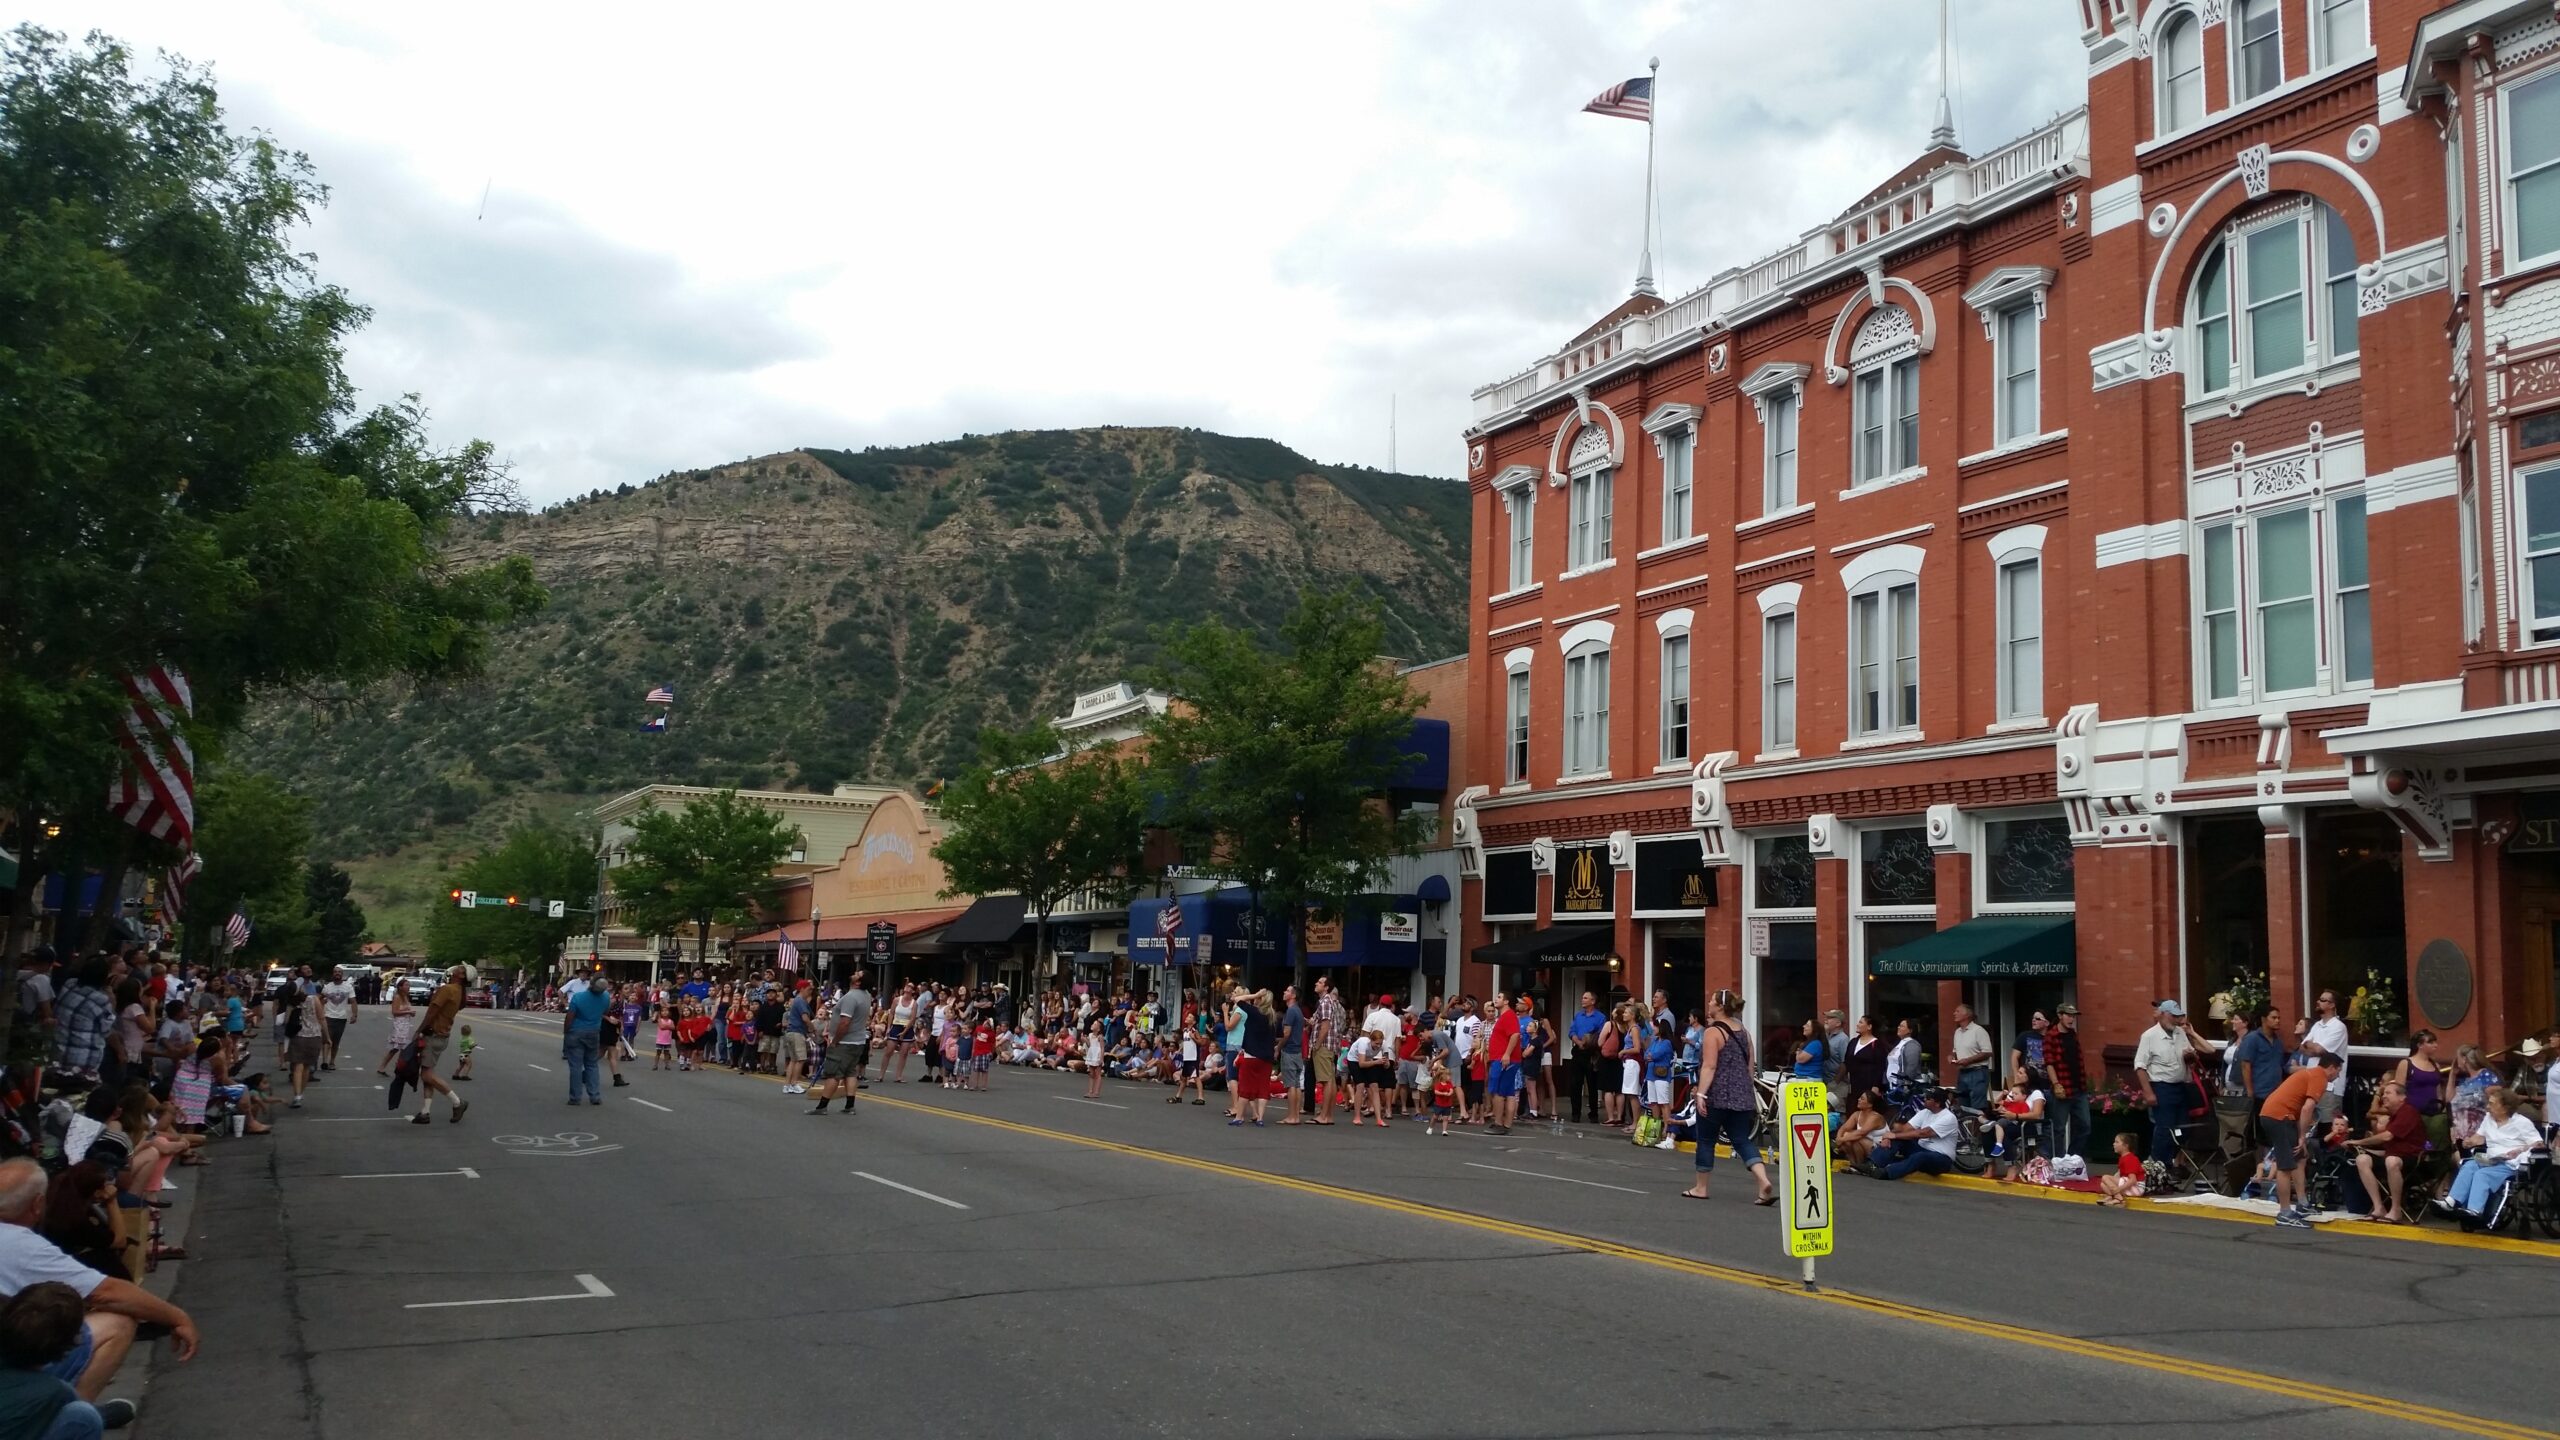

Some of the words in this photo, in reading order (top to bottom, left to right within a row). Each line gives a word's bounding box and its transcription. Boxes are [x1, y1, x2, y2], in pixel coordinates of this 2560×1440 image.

[1577, 850, 1592, 889] M
[1566, 900, 1586, 910] MAHOGANY
[1588, 899, 1602, 909] GRILLE
[1540, 954, 1566, 962] Steaks
[1576, 952, 1606, 962] Seafood
[1879, 960, 1893, 972] The
[1895, 960, 1919, 973] Office
[1921, 961, 1969, 974] Spiritorium
[1981, 961, 2010, 974] Spirits
[2012, 962, 2019, 973] &
[2022, 962, 2069, 976] Appetizers
[1793, 1087, 1819, 1098] STATE
[1797, 1100, 1815, 1110] LAW
[1807, 1165, 1815, 1174] TO
[1802, 1232, 1822, 1241] WITHIN
[1796, 1242, 1829, 1252] CROSSWALK
